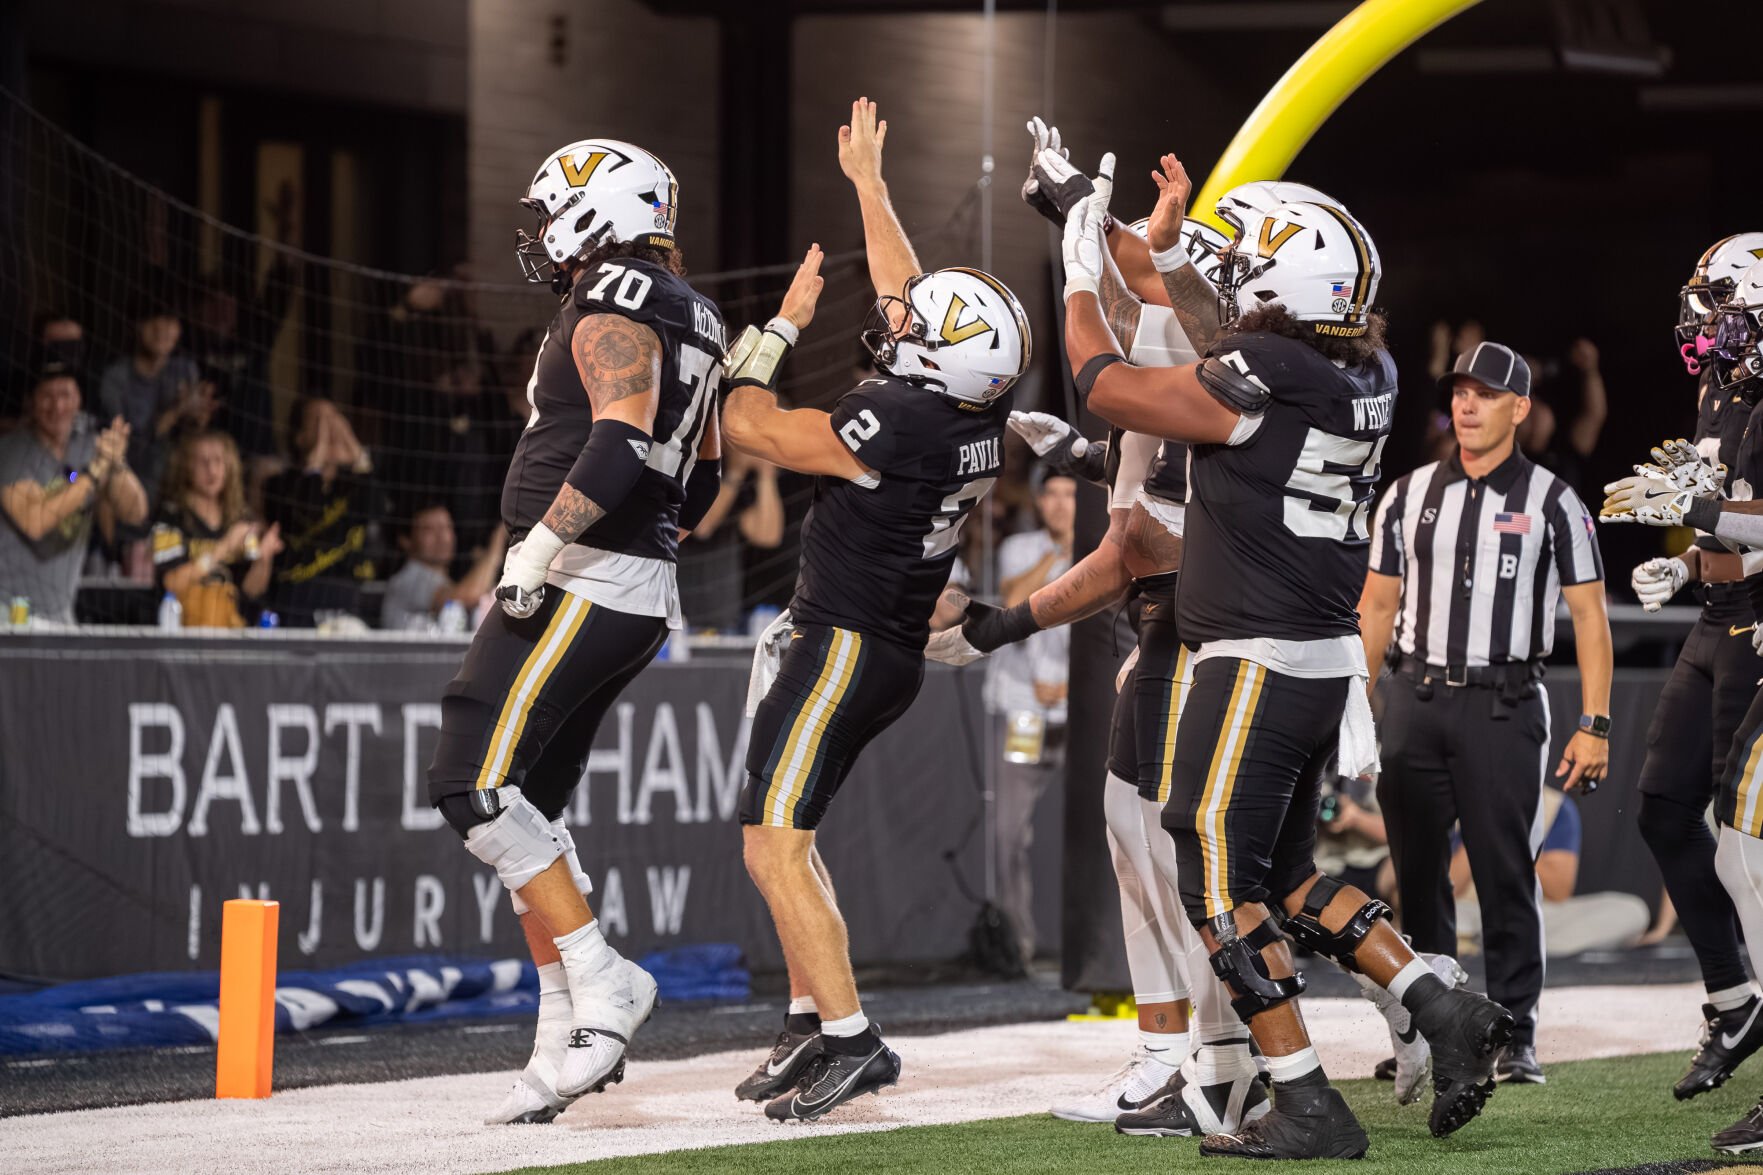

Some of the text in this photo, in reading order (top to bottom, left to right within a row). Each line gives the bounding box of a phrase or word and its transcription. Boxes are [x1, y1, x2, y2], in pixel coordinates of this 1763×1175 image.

[558, 152, 611, 188] V
[1257, 216, 1307, 259] V
[586, 262, 653, 311] 70
[939, 292, 993, 346] V
[839, 409, 881, 452] 2
[957, 437, 1000, 475] PAVIA
[1421, 507, 1437, 524] S
[1500, 553, 1518, 579] B
[127, 702, 750, 837] BART DHAM
[187, 867, 691, 959] IJURY AW
